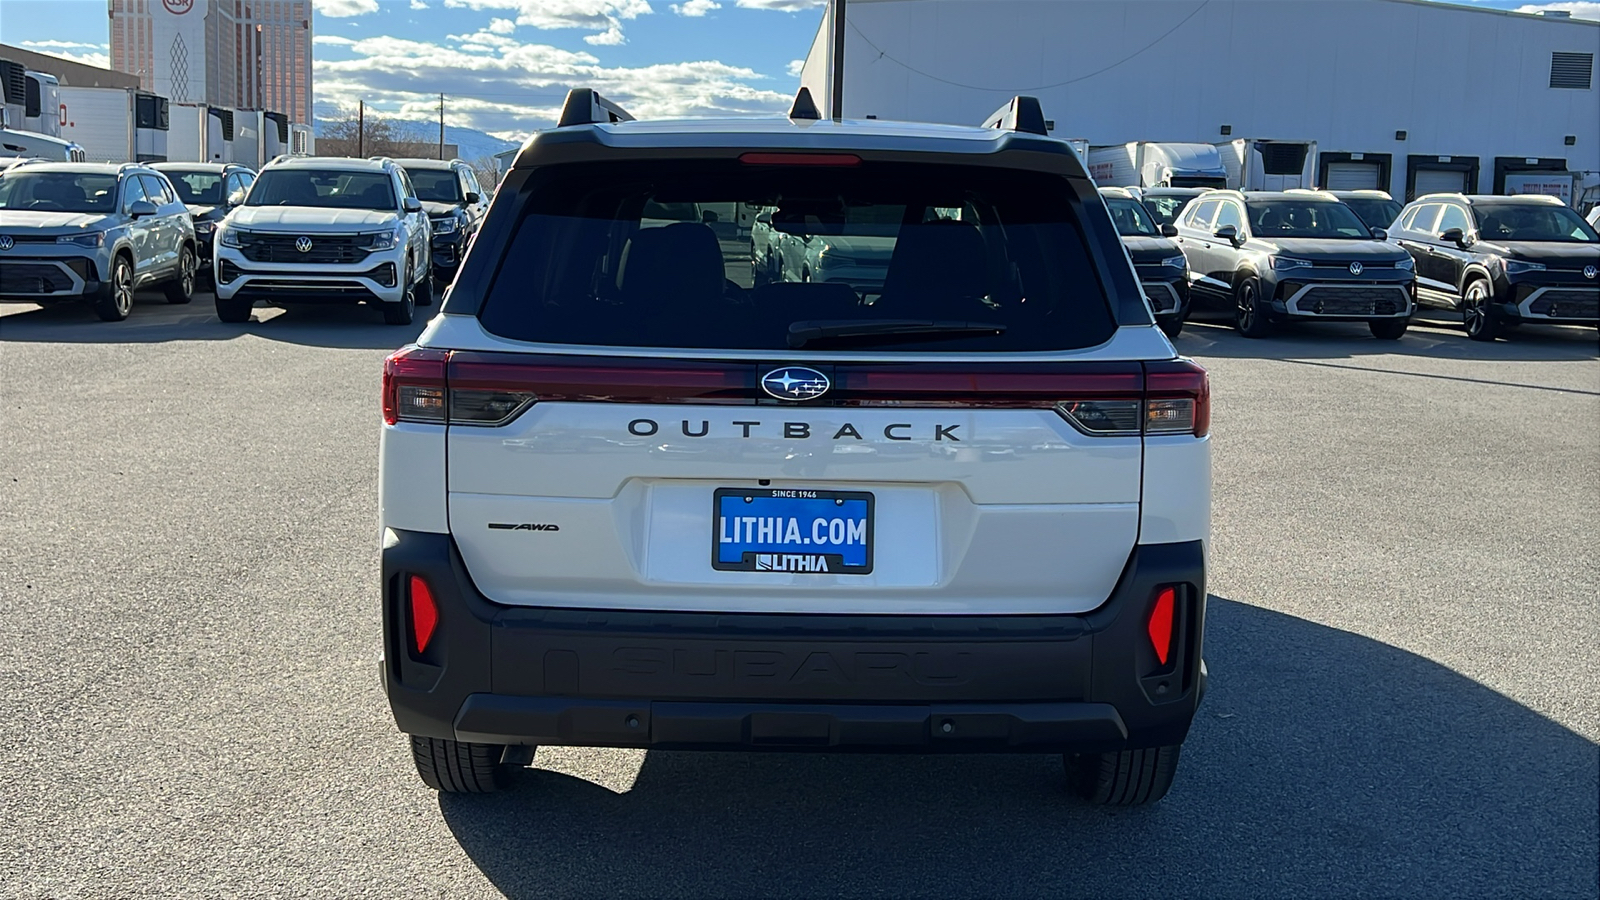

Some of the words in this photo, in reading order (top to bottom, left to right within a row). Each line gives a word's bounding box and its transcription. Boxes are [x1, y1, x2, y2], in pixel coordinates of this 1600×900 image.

[627, 418, 961, 441] OUTBACK
[772, 490, 796, 498] SINCE
[514, 523, 560, 531] AWD
[719, 516, 867, 545] LITHIA.COM
[772, 555, 829, 572] LITHIA
[612, 646, 976, 687] SUBARU
